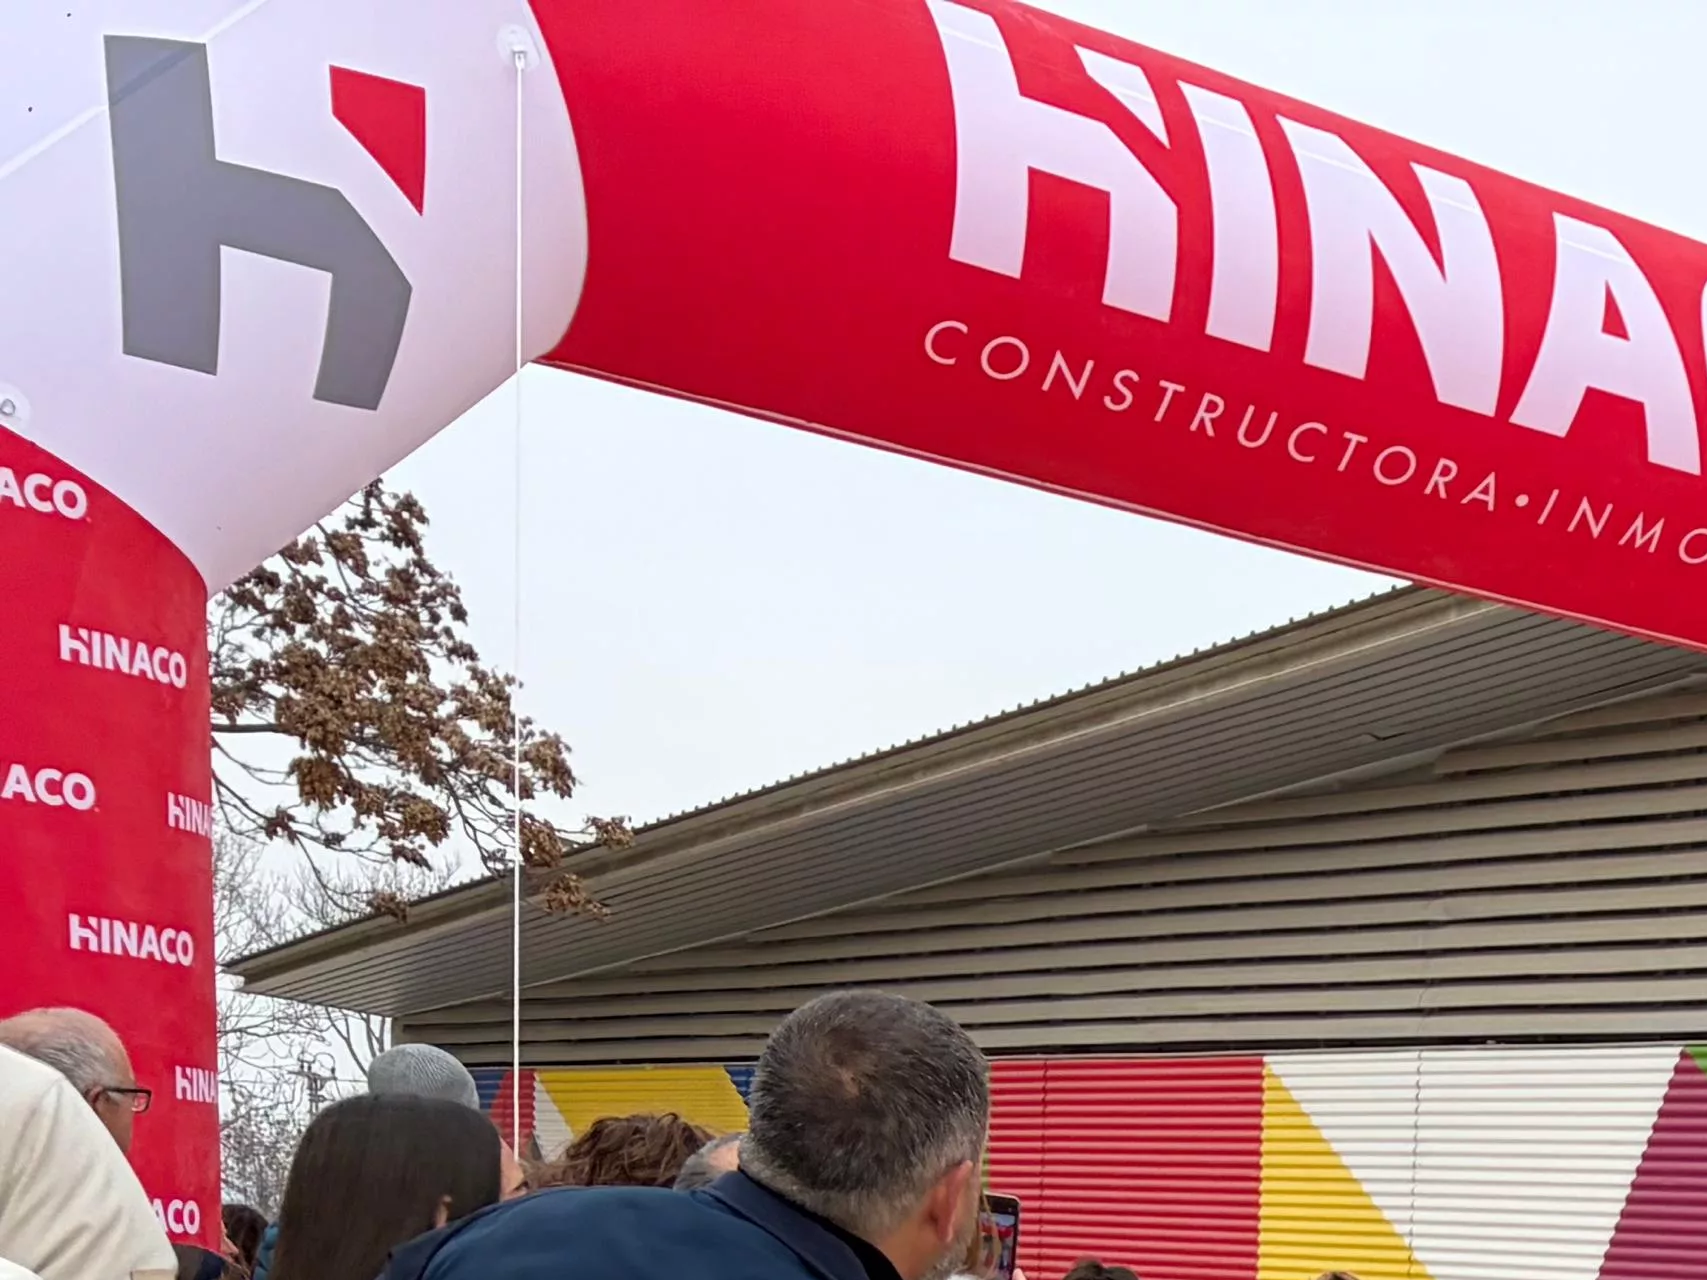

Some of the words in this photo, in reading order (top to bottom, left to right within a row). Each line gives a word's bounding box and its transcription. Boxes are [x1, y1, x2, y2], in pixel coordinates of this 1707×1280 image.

[0, 466, 88, 520] ACO
[58, 624, 187, 689] HINACO
[1, 763, 97, 811] ACO
[168, 791, 213, 838] HINA
[68, 913, 194, 967] HINACO
[175, 1064, 218, 1104] HINA
[150, 1198, 200, 1235] ACO
